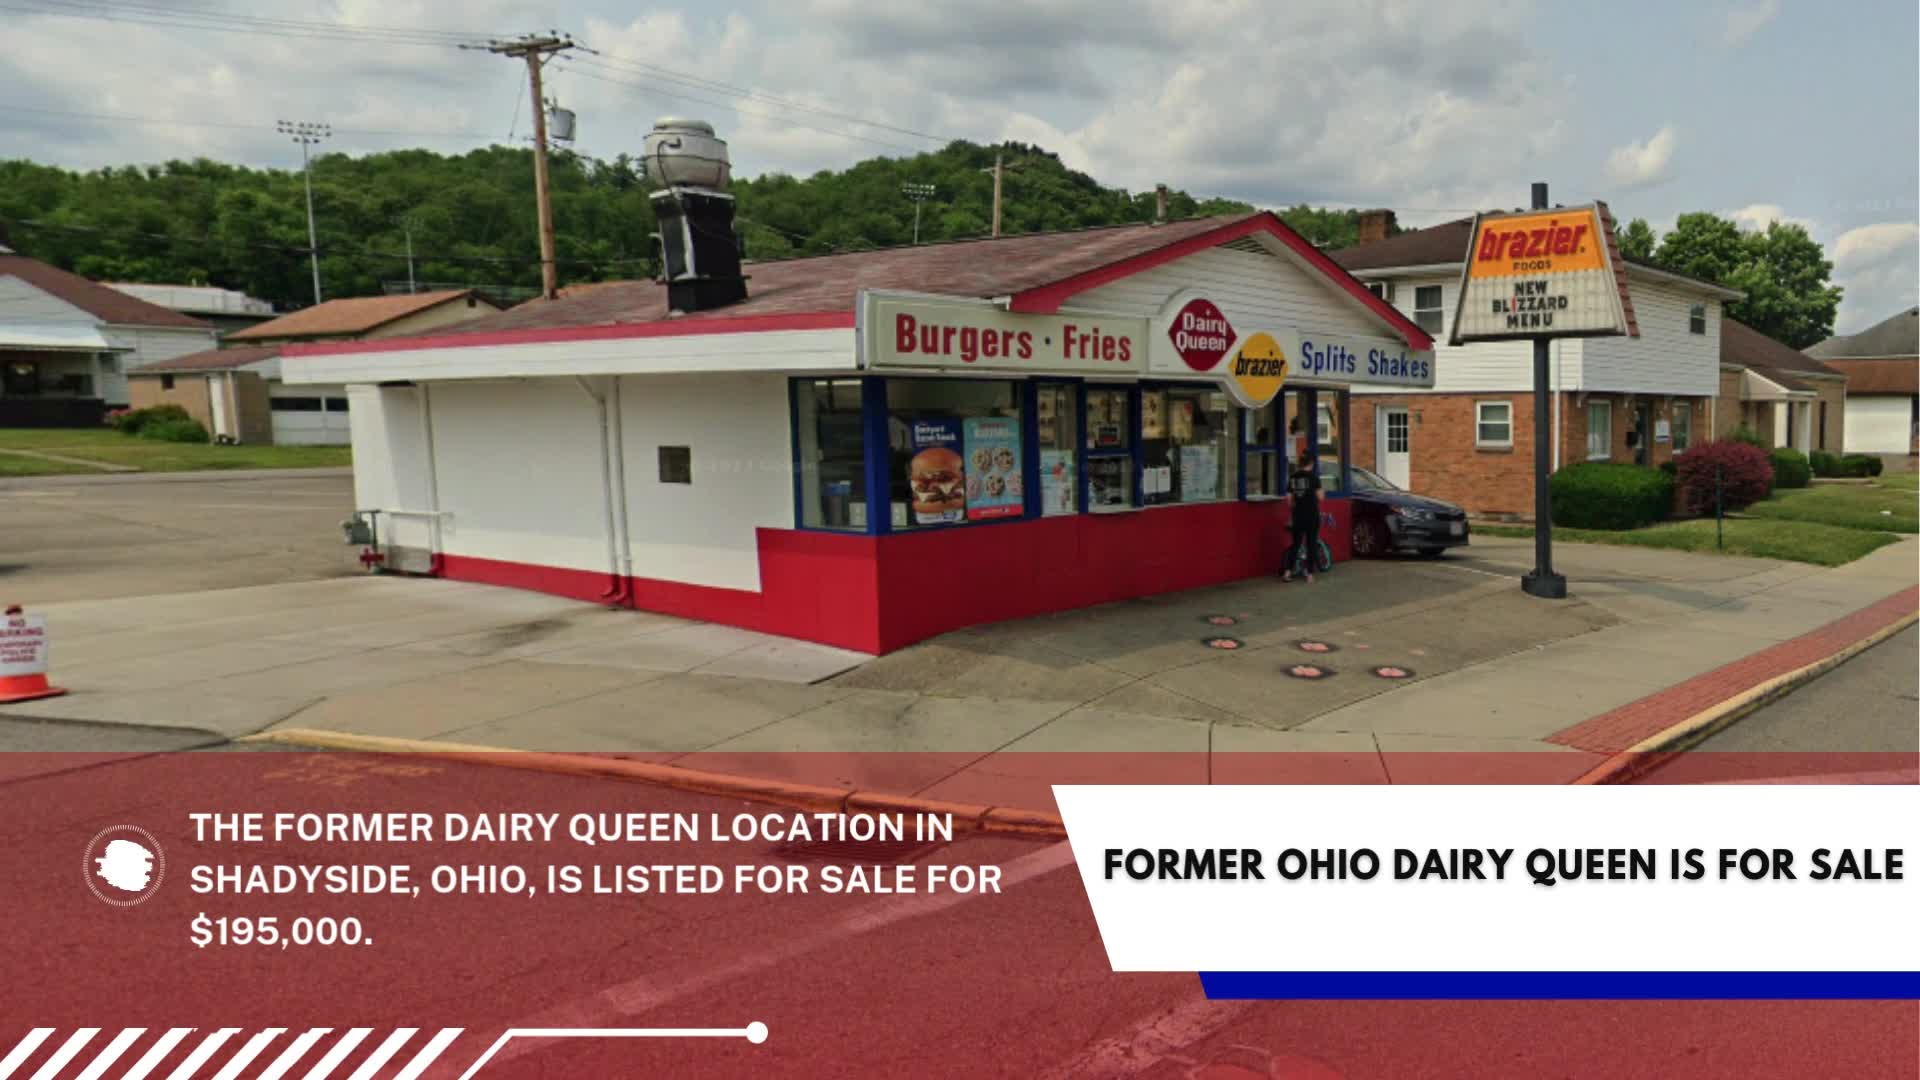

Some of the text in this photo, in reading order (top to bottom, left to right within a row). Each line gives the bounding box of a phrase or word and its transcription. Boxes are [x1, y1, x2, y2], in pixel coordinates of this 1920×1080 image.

[1514, 280, 1549, 297] NEW
[1492, 295, 1569, 315] BLIZZARD
[1182, 308, 1228, 337] Dairy
[1507, 313, 1553, 329] MENU
[896, 312, 1132, 363] Burgers Fries
[1175, 331, 1227, 353] Queen
[1235, 349, 1286, 377] brazier
[1301, 340, 1430, 379] Splits Shakes
